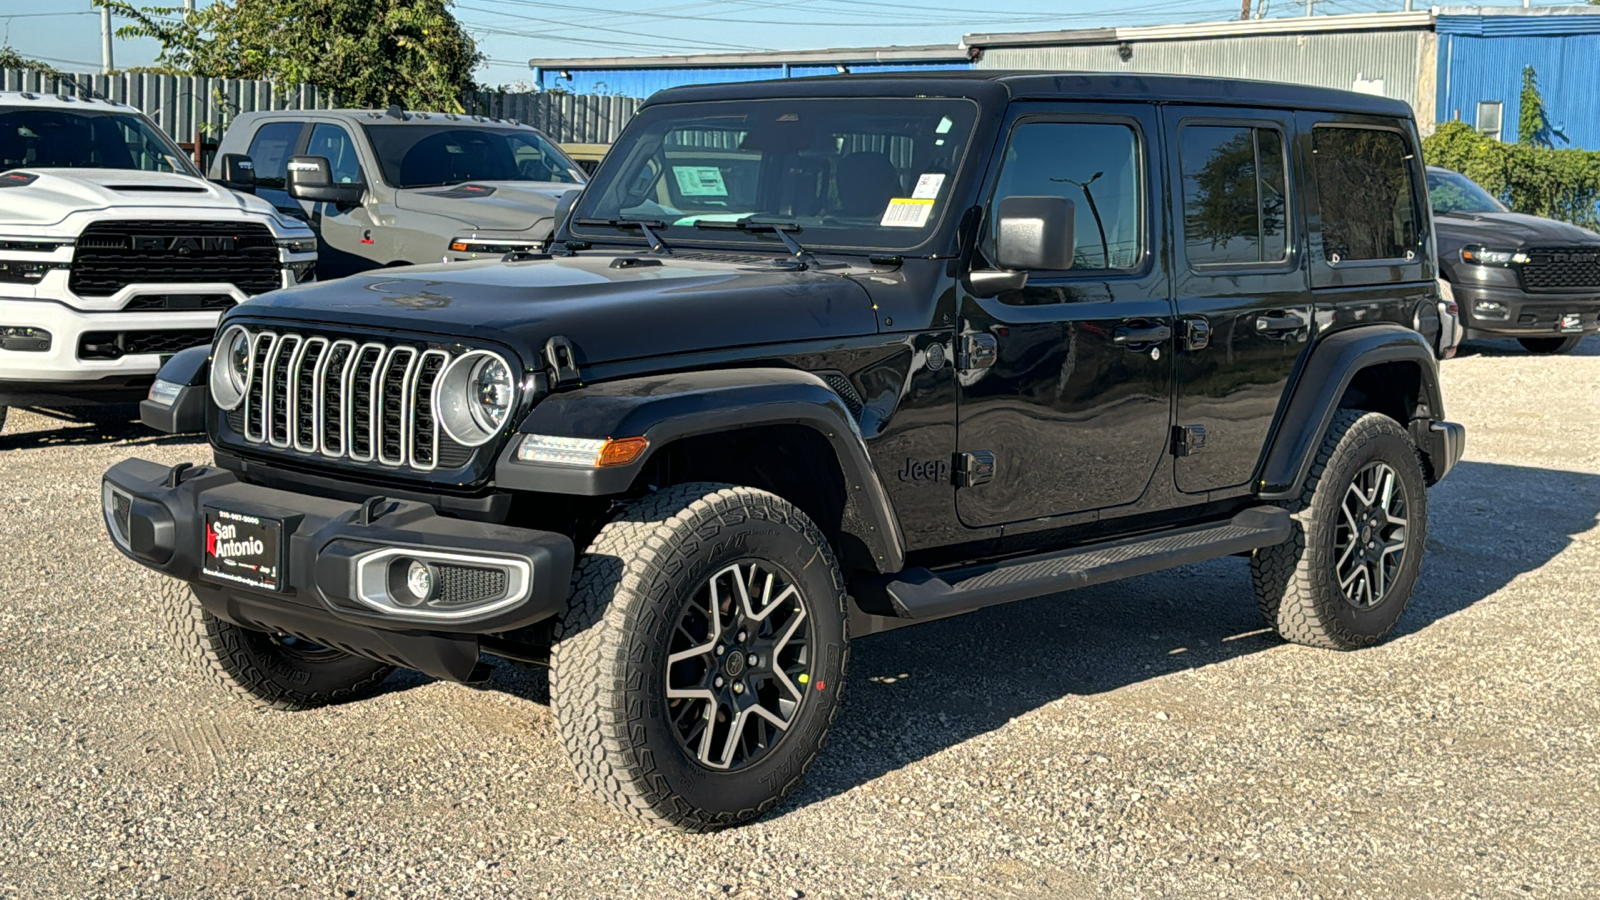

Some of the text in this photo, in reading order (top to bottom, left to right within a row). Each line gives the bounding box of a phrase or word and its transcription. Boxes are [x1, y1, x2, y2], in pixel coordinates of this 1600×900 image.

[129, 235, 235, 252] RAM
[898, 457, 947, 482] Jeep
[213, 521, 236, 540] San
[215, 536, 264, 558] Antonio
[707, 529, 751, 565] A/T
[758, 642, 840, 792] GENERAL
